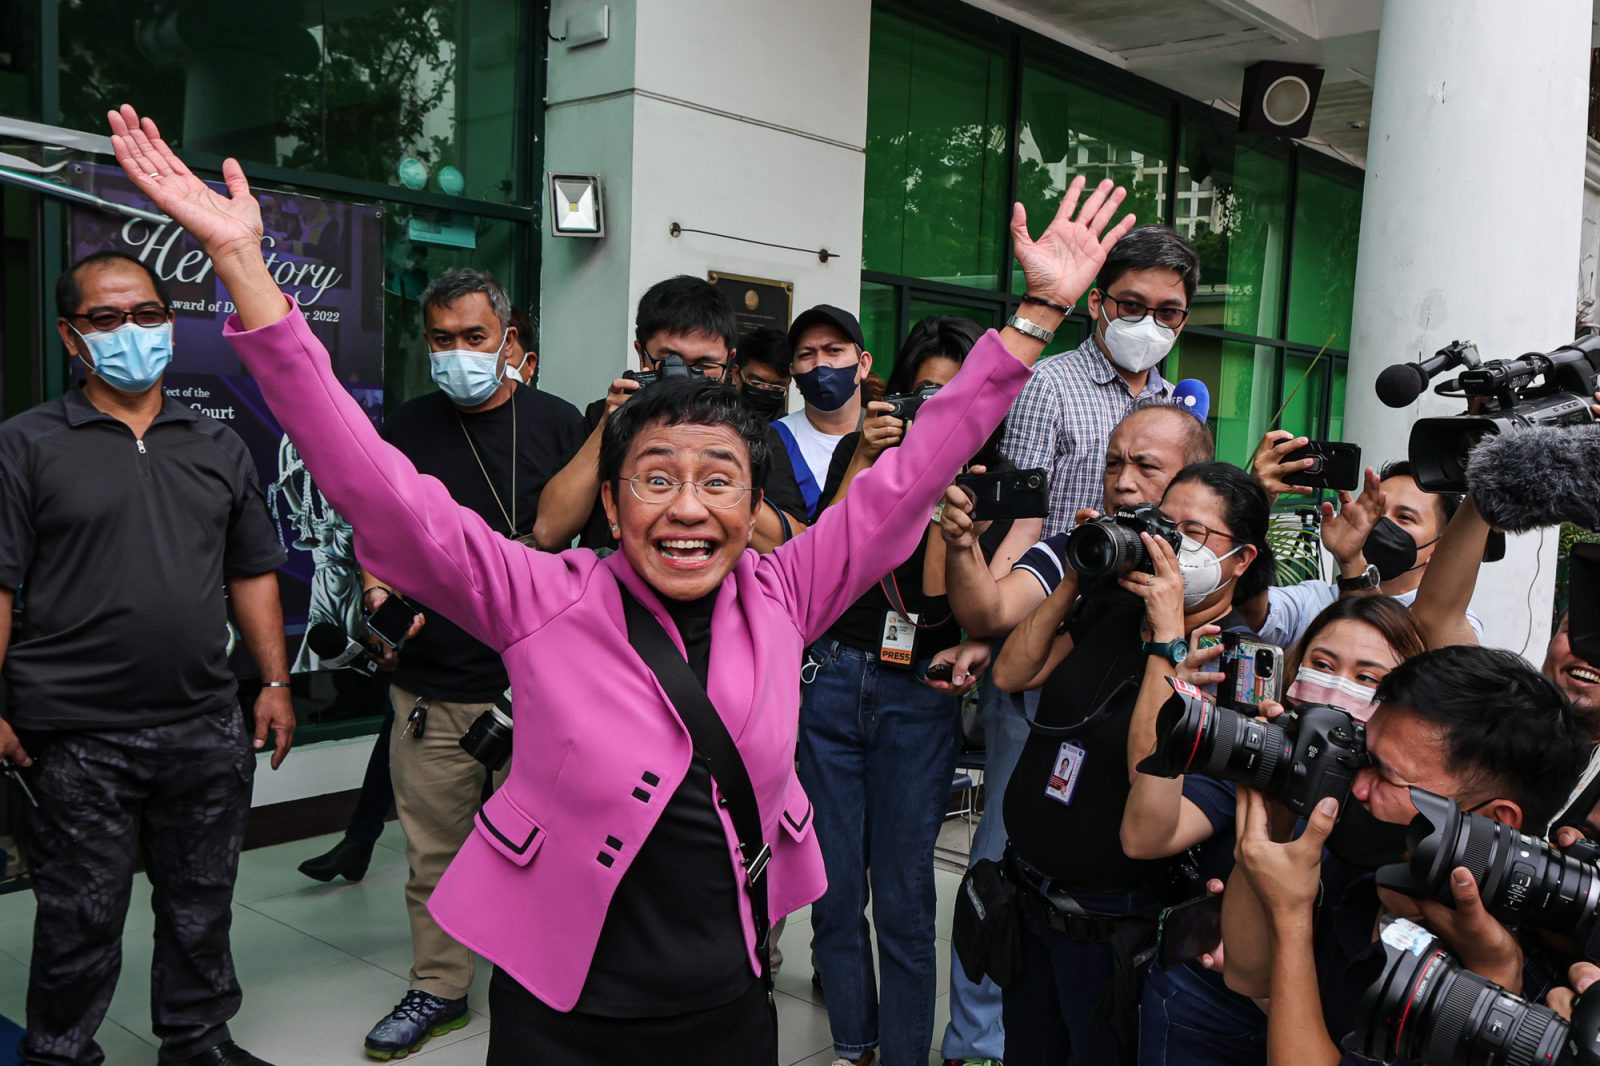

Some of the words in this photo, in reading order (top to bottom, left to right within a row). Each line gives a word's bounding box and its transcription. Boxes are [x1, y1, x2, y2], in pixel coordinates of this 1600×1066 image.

[169, 299, 205, 312] ward
[207, 300, 222, 313] of
[312, 310, 340, 323] 2022
[182, 387, 193, 397] of
[194, 387, 211, 398] the
[1117, 510, 1136, 519] Nikon
[882, 650, 911, 662] PRESS
